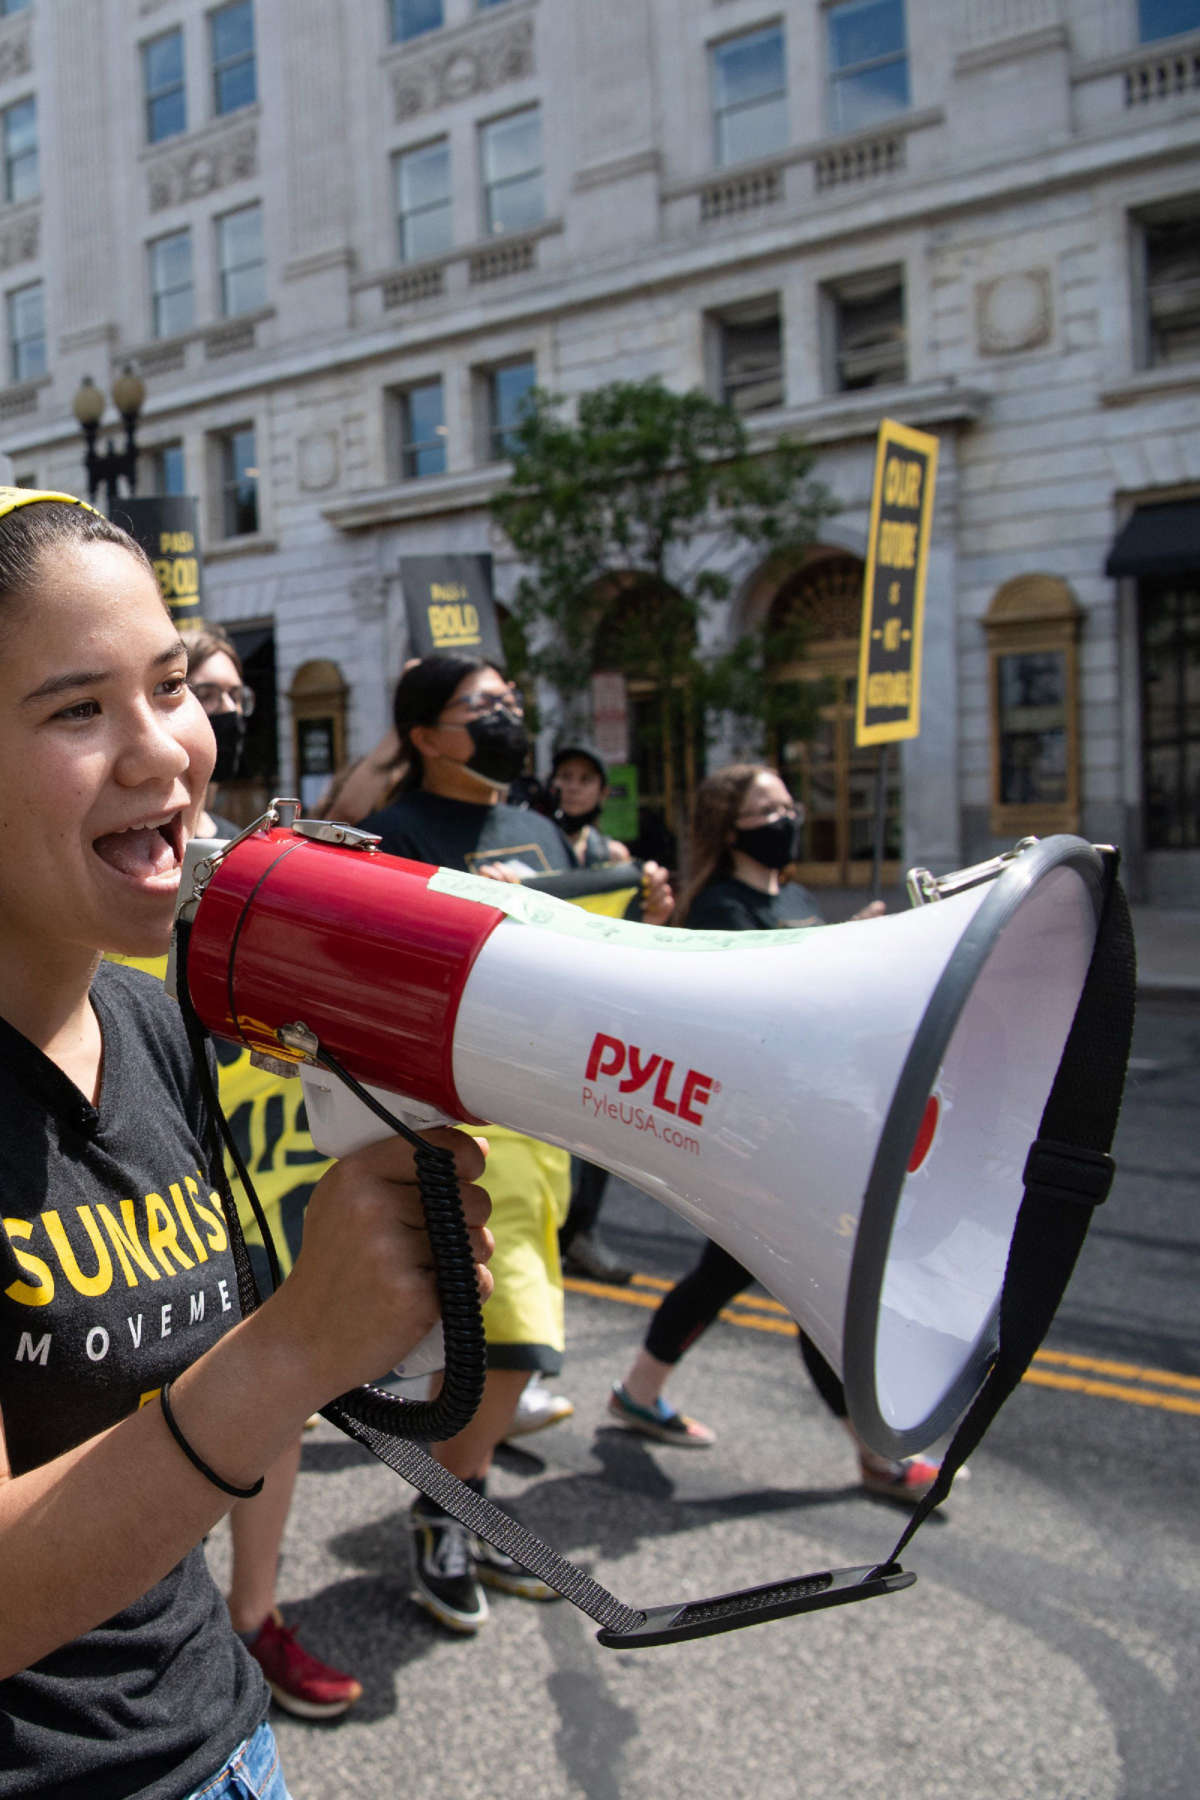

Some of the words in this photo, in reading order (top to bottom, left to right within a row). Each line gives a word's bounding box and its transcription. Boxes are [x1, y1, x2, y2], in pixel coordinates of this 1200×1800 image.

[428, 603, 479, 638] BOLD
[581, 1085, 700, 1157] PyleUSA.com
[2, 1174, 230, 1308] SUNRIS
[14, 1279, 233, 1367] MOVEME
